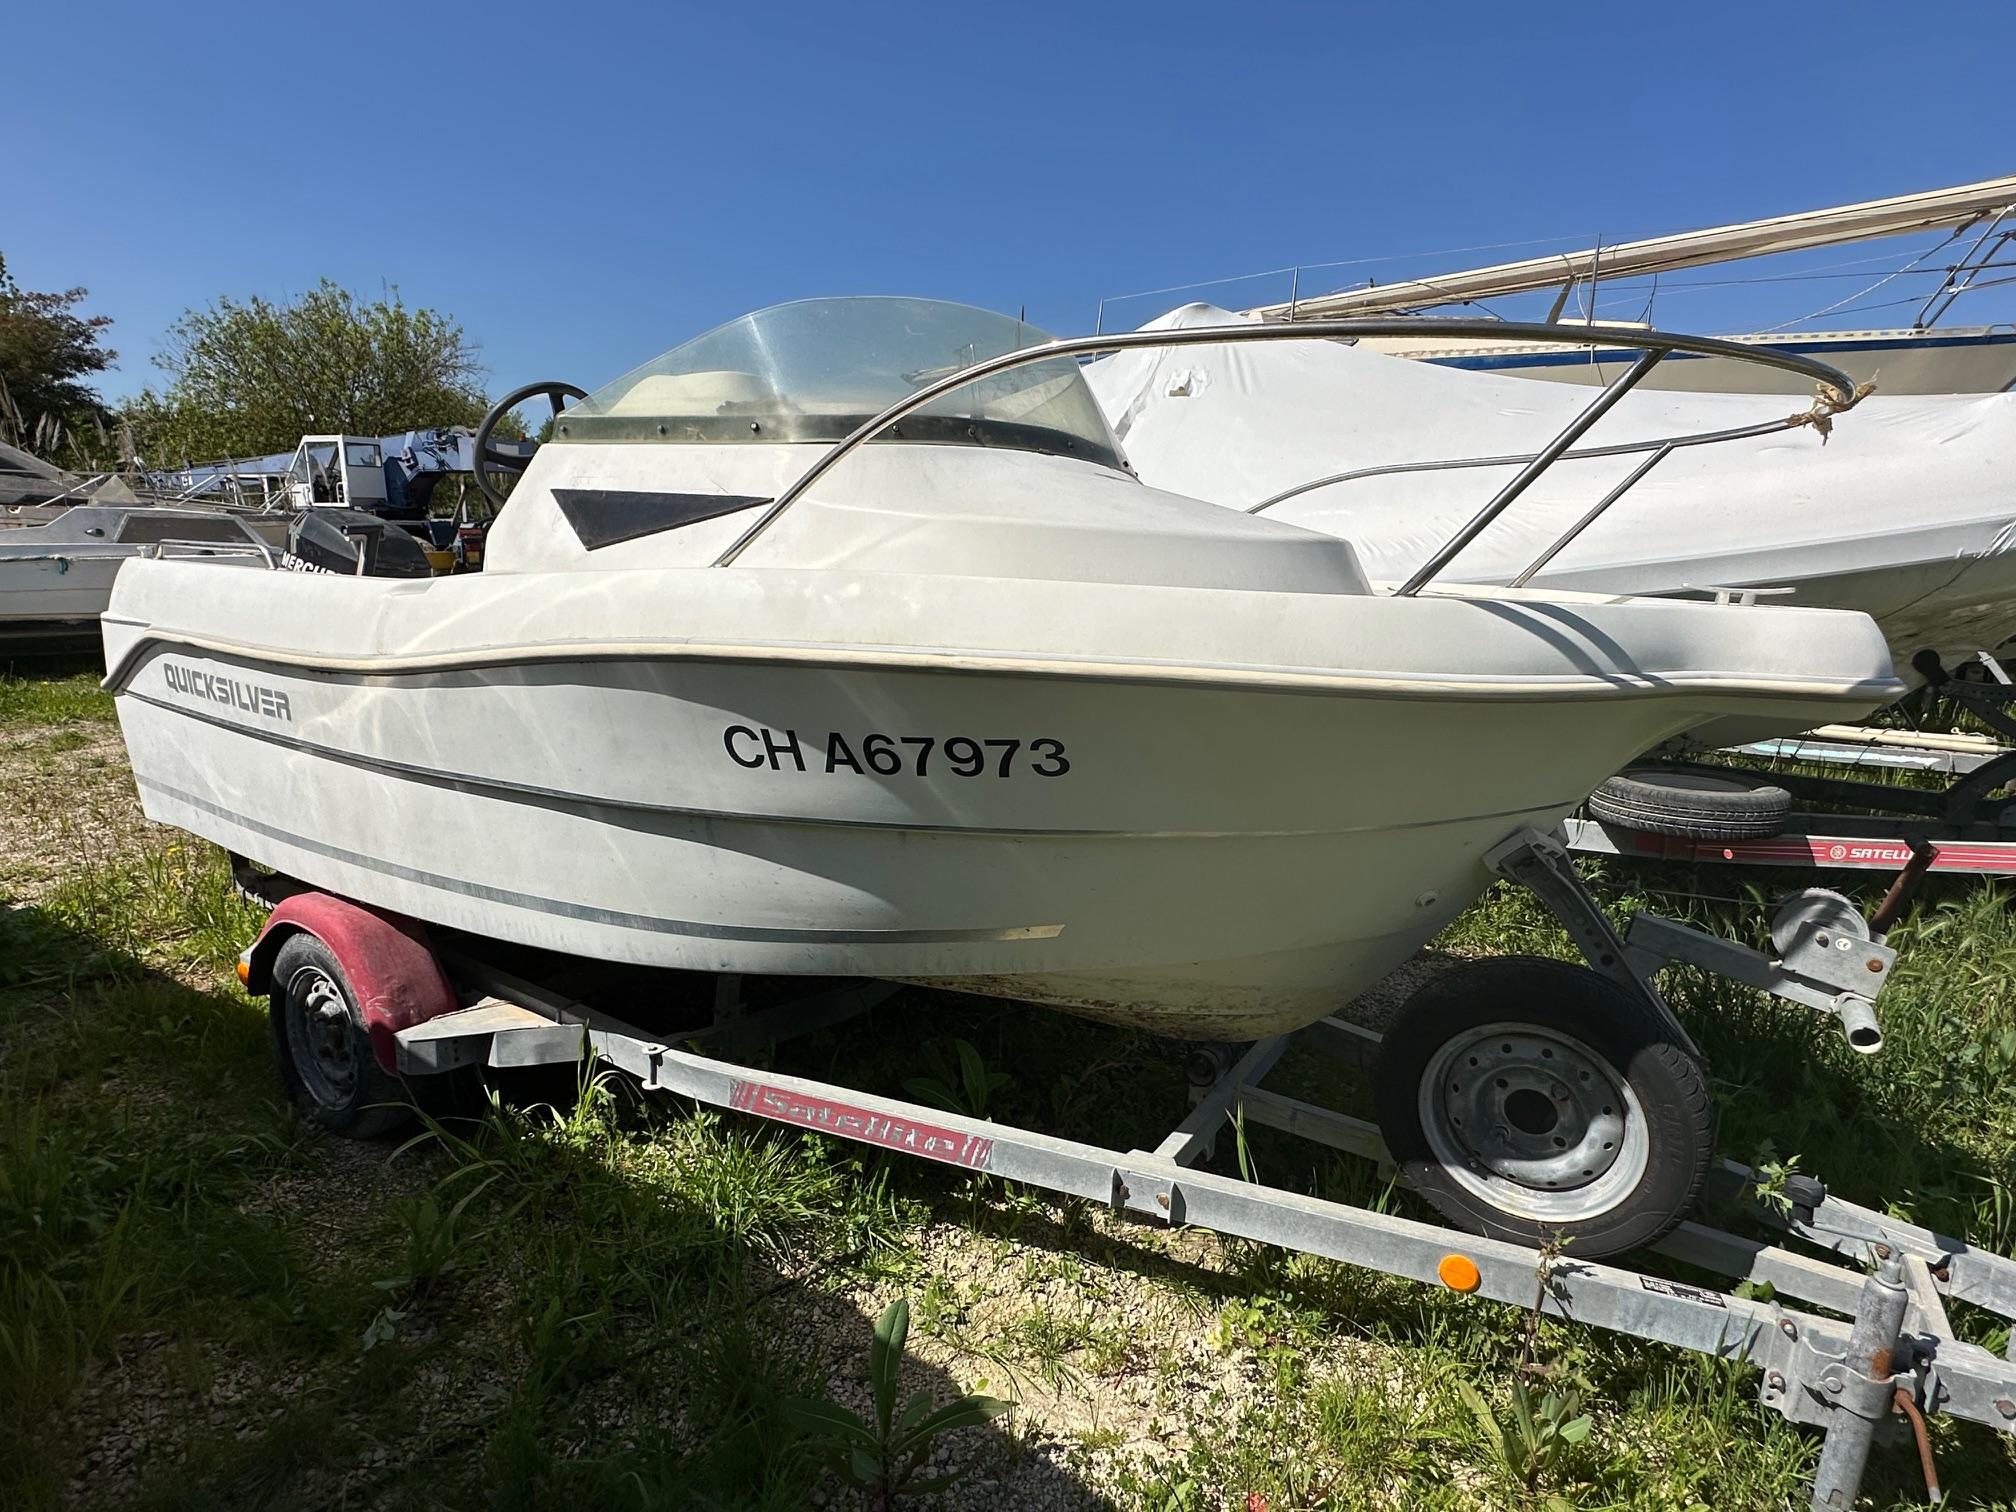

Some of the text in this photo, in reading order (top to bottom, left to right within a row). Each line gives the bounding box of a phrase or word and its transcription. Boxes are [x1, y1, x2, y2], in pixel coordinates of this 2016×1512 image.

[281, 550, 340, 575] MERCU
[163, 662, 292, 722] QUICKSILVER
[723, 724, 1071, 778] CH A67973
